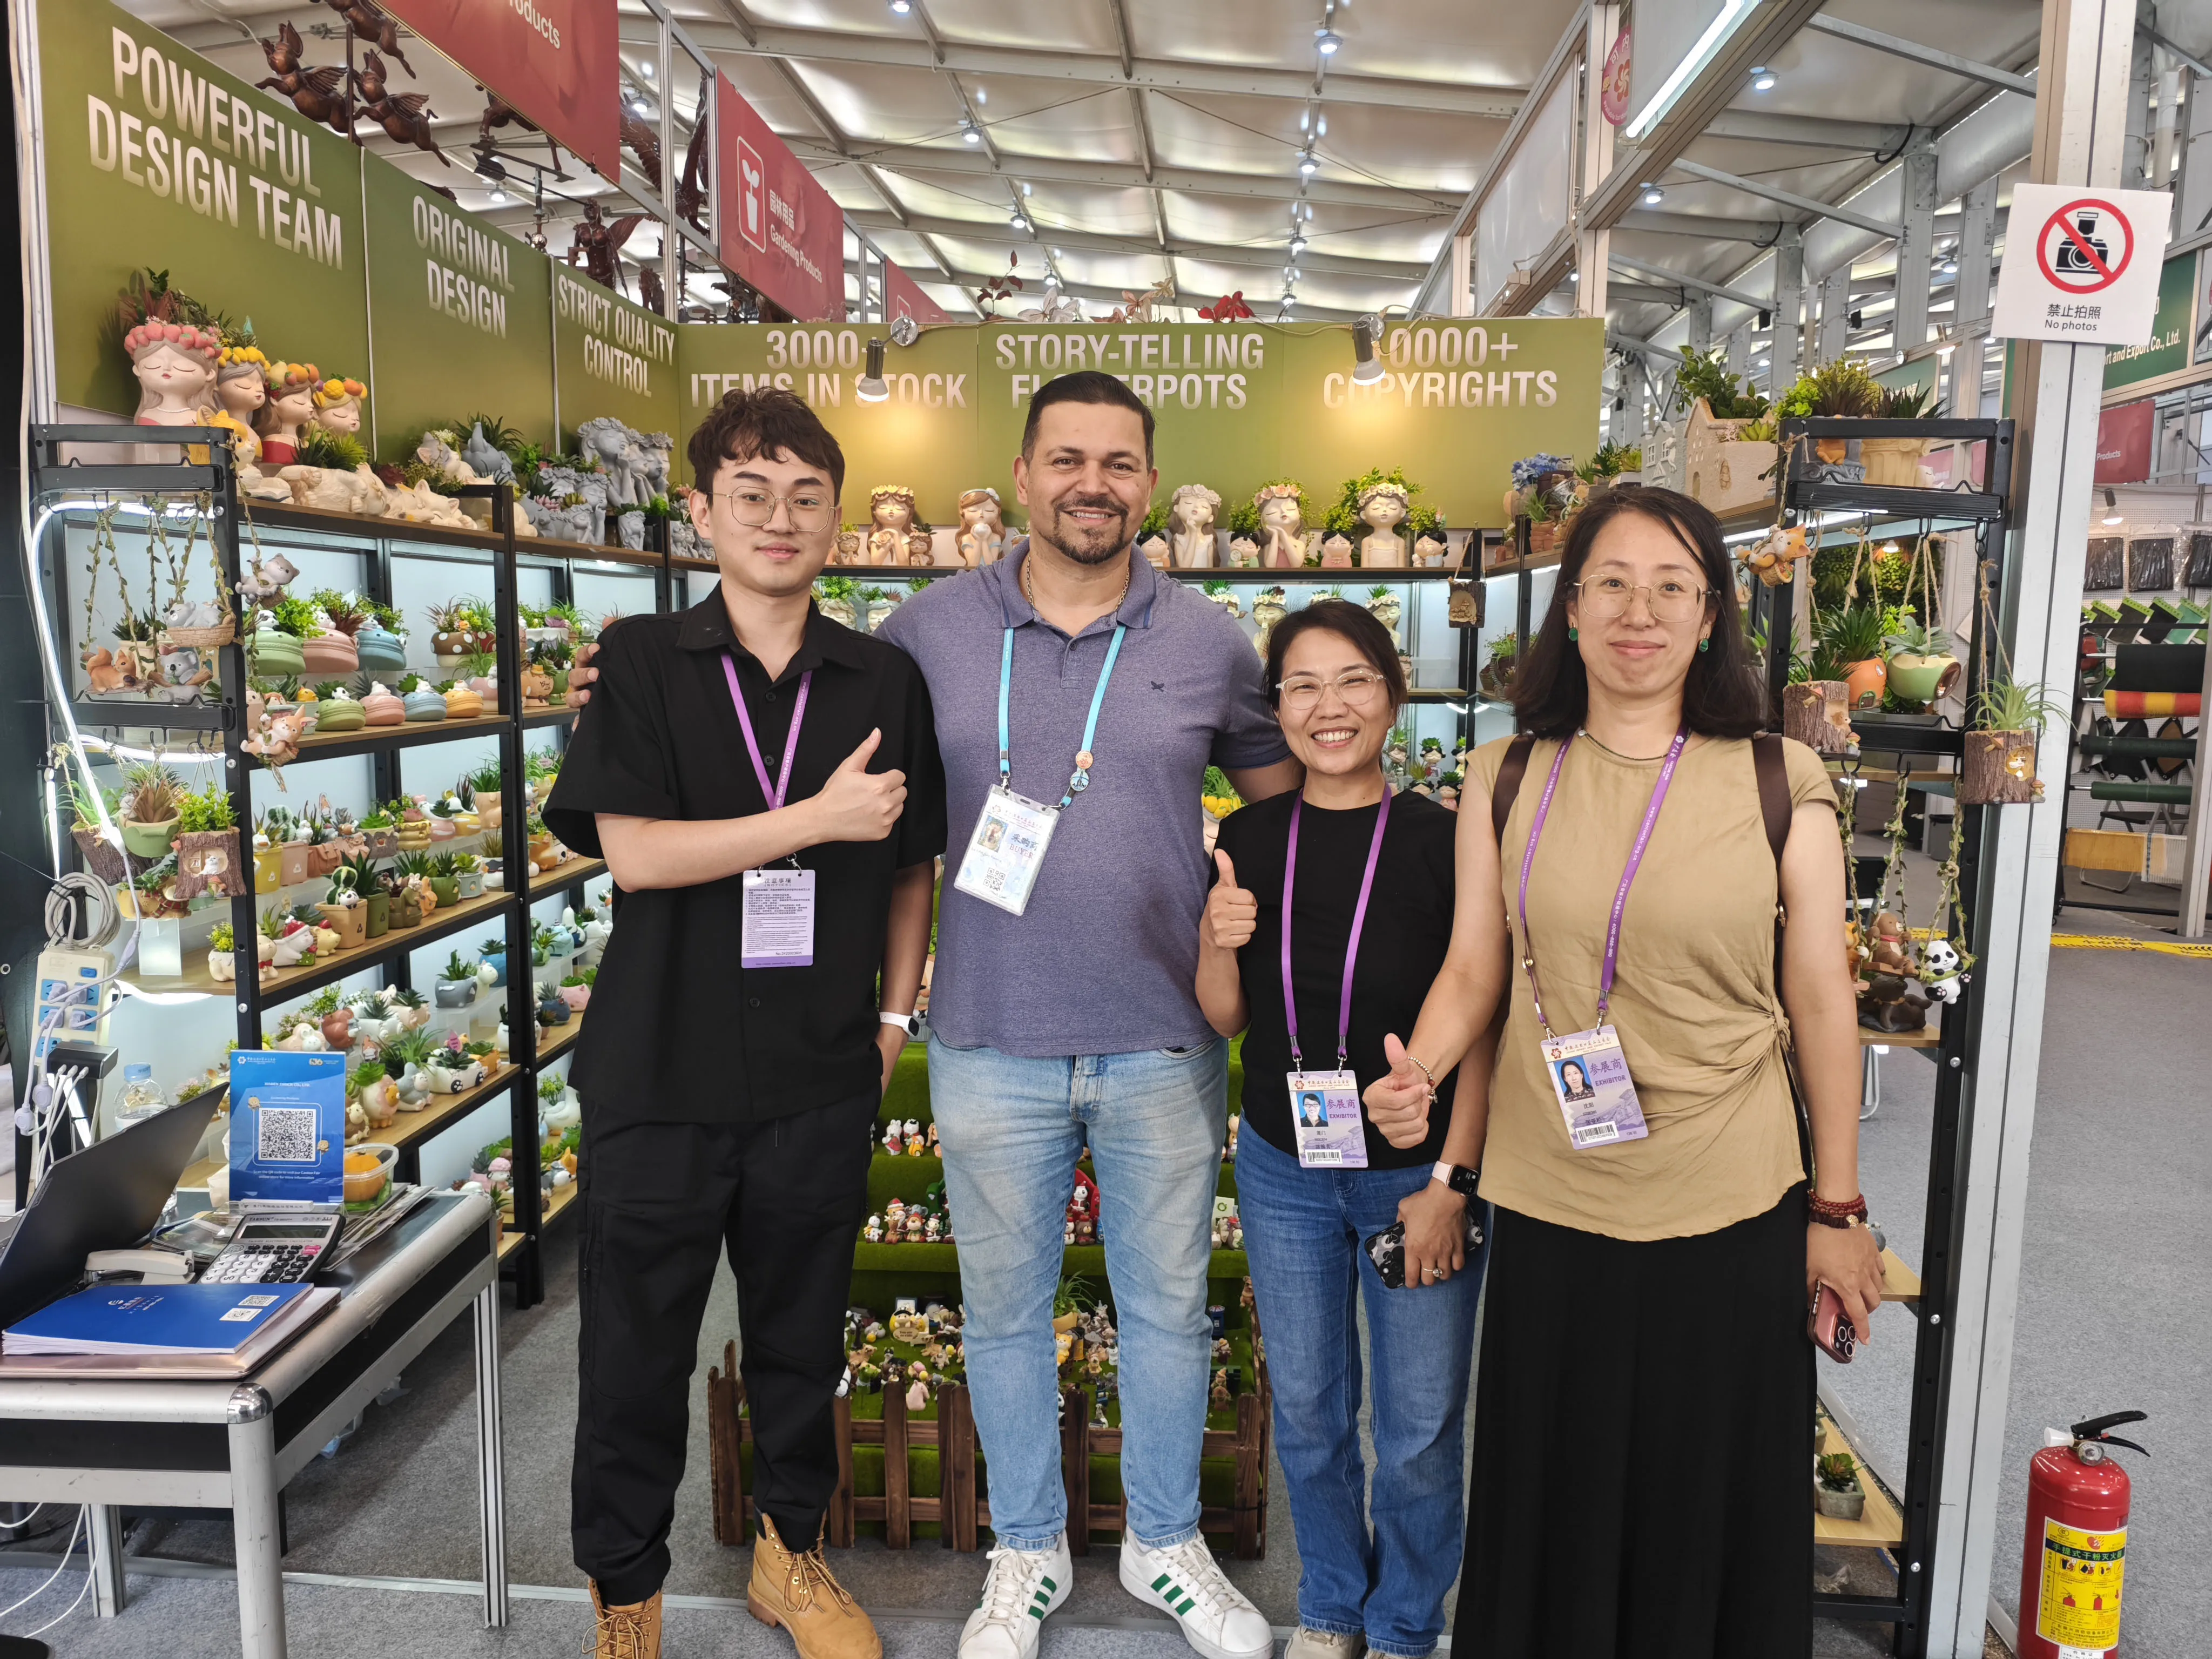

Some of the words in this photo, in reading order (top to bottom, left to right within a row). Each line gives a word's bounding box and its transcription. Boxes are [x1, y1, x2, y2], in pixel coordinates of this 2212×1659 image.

[509, 0, 561, 49] oducts
[112, 26, 321, 198] POWERFUL
[87, 94, 239, 228] DESIGN
[249, 175, 342, 271] TEAM
[413, 195, 515, 292] ORIGINAL
[770, 224, 799, 267] Gardening
[800, 250, 822, 284] Products
[427, 259, 506, 339] DESIGN
[2047, 304, 2101, 319] 禁止拍照
[558, 274, 611, 337] STRICT
[615, 306, 675, 366] QUALITY
[2045, 319, 2059, 328] No
[2061, 321, 2097, 331] photos
[996, 333, 1264, 369] STORY-TELLING
[1372, 327, 1519, 368] 0000+
[2112, 346, 2126, 363] and
[2150, 336, 2164, 351] Co.,
[2166, 328, 2180, 347] Ltd.
[584, 334, 651, 397] CONTROL
[808, 373, 840, 407] IN
[1012, 373, 1246, 409] FRPOTS
[2097, 450, 2121, 460] Products
[1010, 844, 1034, 859] BUYER
[1633, 806, 1655, 861] www.cantonfair.org.cn
[1590, 1058, 1622, 1076] 参展商
[1595, 1075, 1627, 1087] EXHIBITOR
[1326, 1098, 1356, 1110] 参展商
[2053, 1543, 2122, 1560] 手提式干粉灭火器
